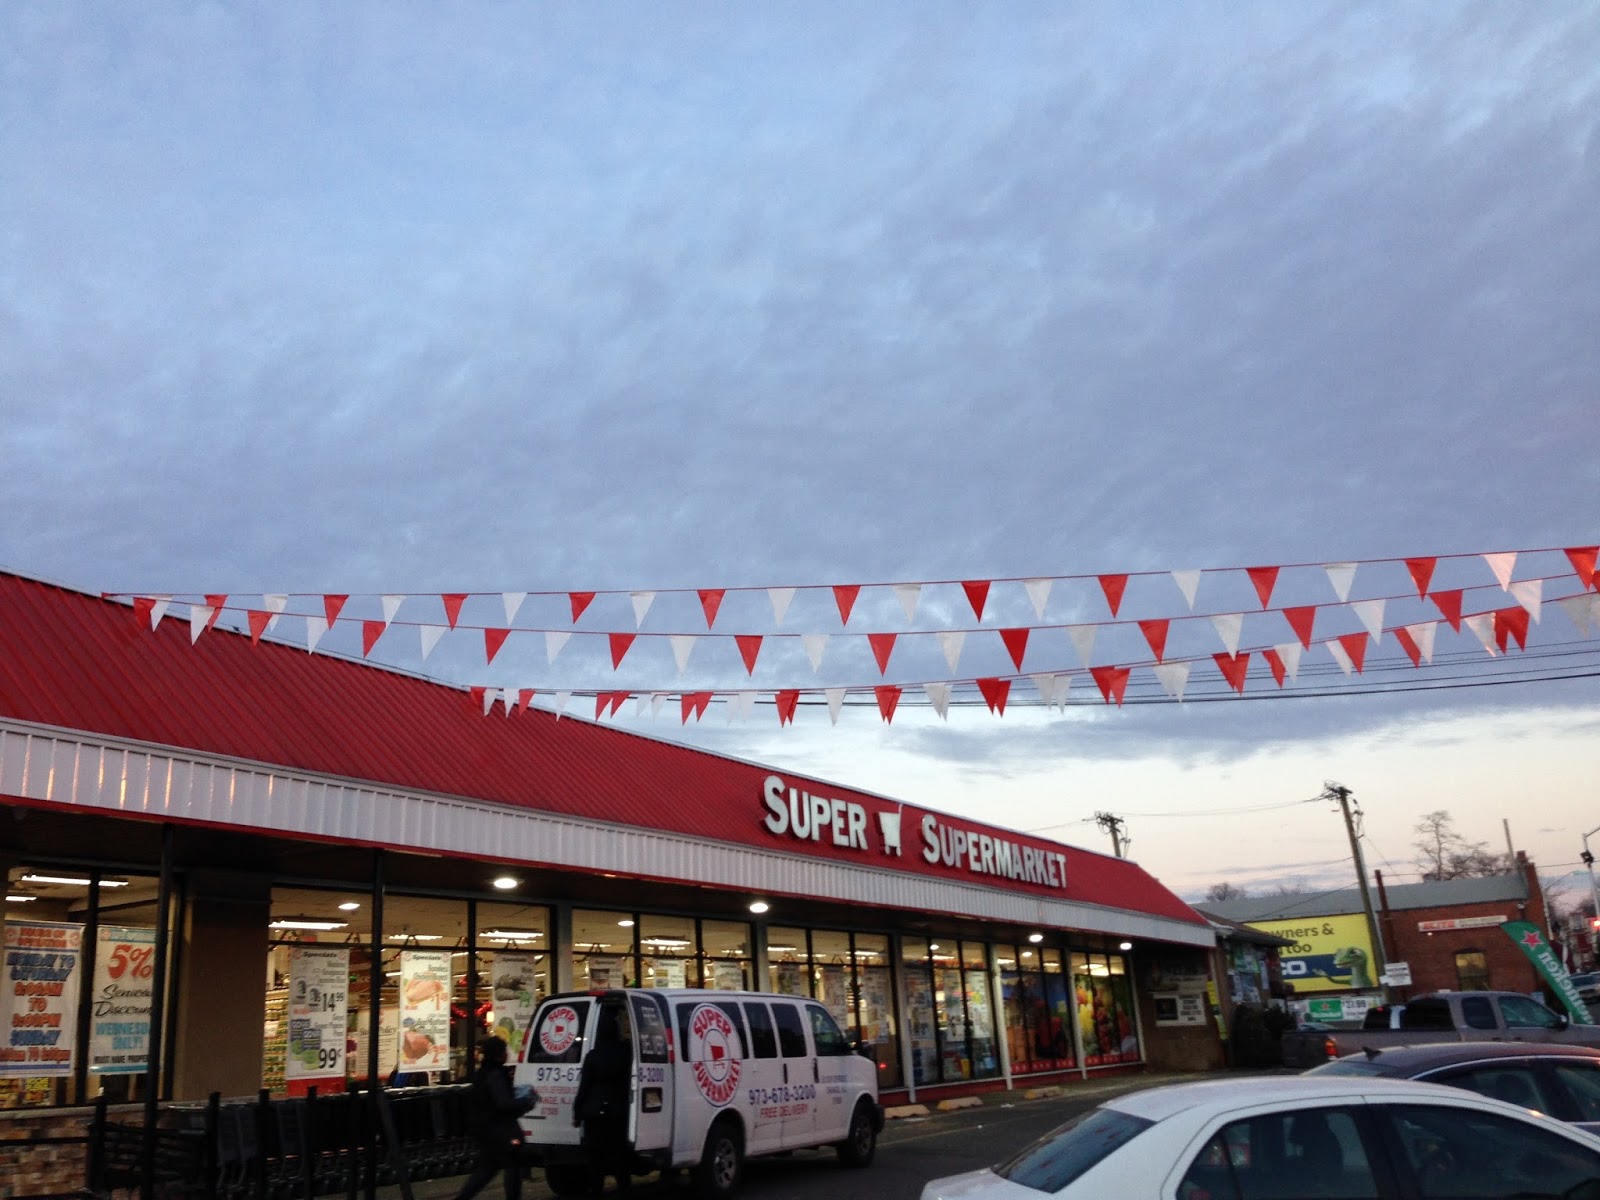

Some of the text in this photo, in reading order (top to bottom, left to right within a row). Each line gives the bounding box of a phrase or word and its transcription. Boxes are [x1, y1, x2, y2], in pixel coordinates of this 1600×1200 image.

[921, 813, 1067, 888] SUPERMARKET
[107, 943, 154, 980] 5%
[92, 1000, 153, 1018] Discoun
[547, 1007, 576, 1023] SUPER
[693, 1008, 732, 1040] SUPER
[693, 1057, 742, 1104] SUPERMARKET
